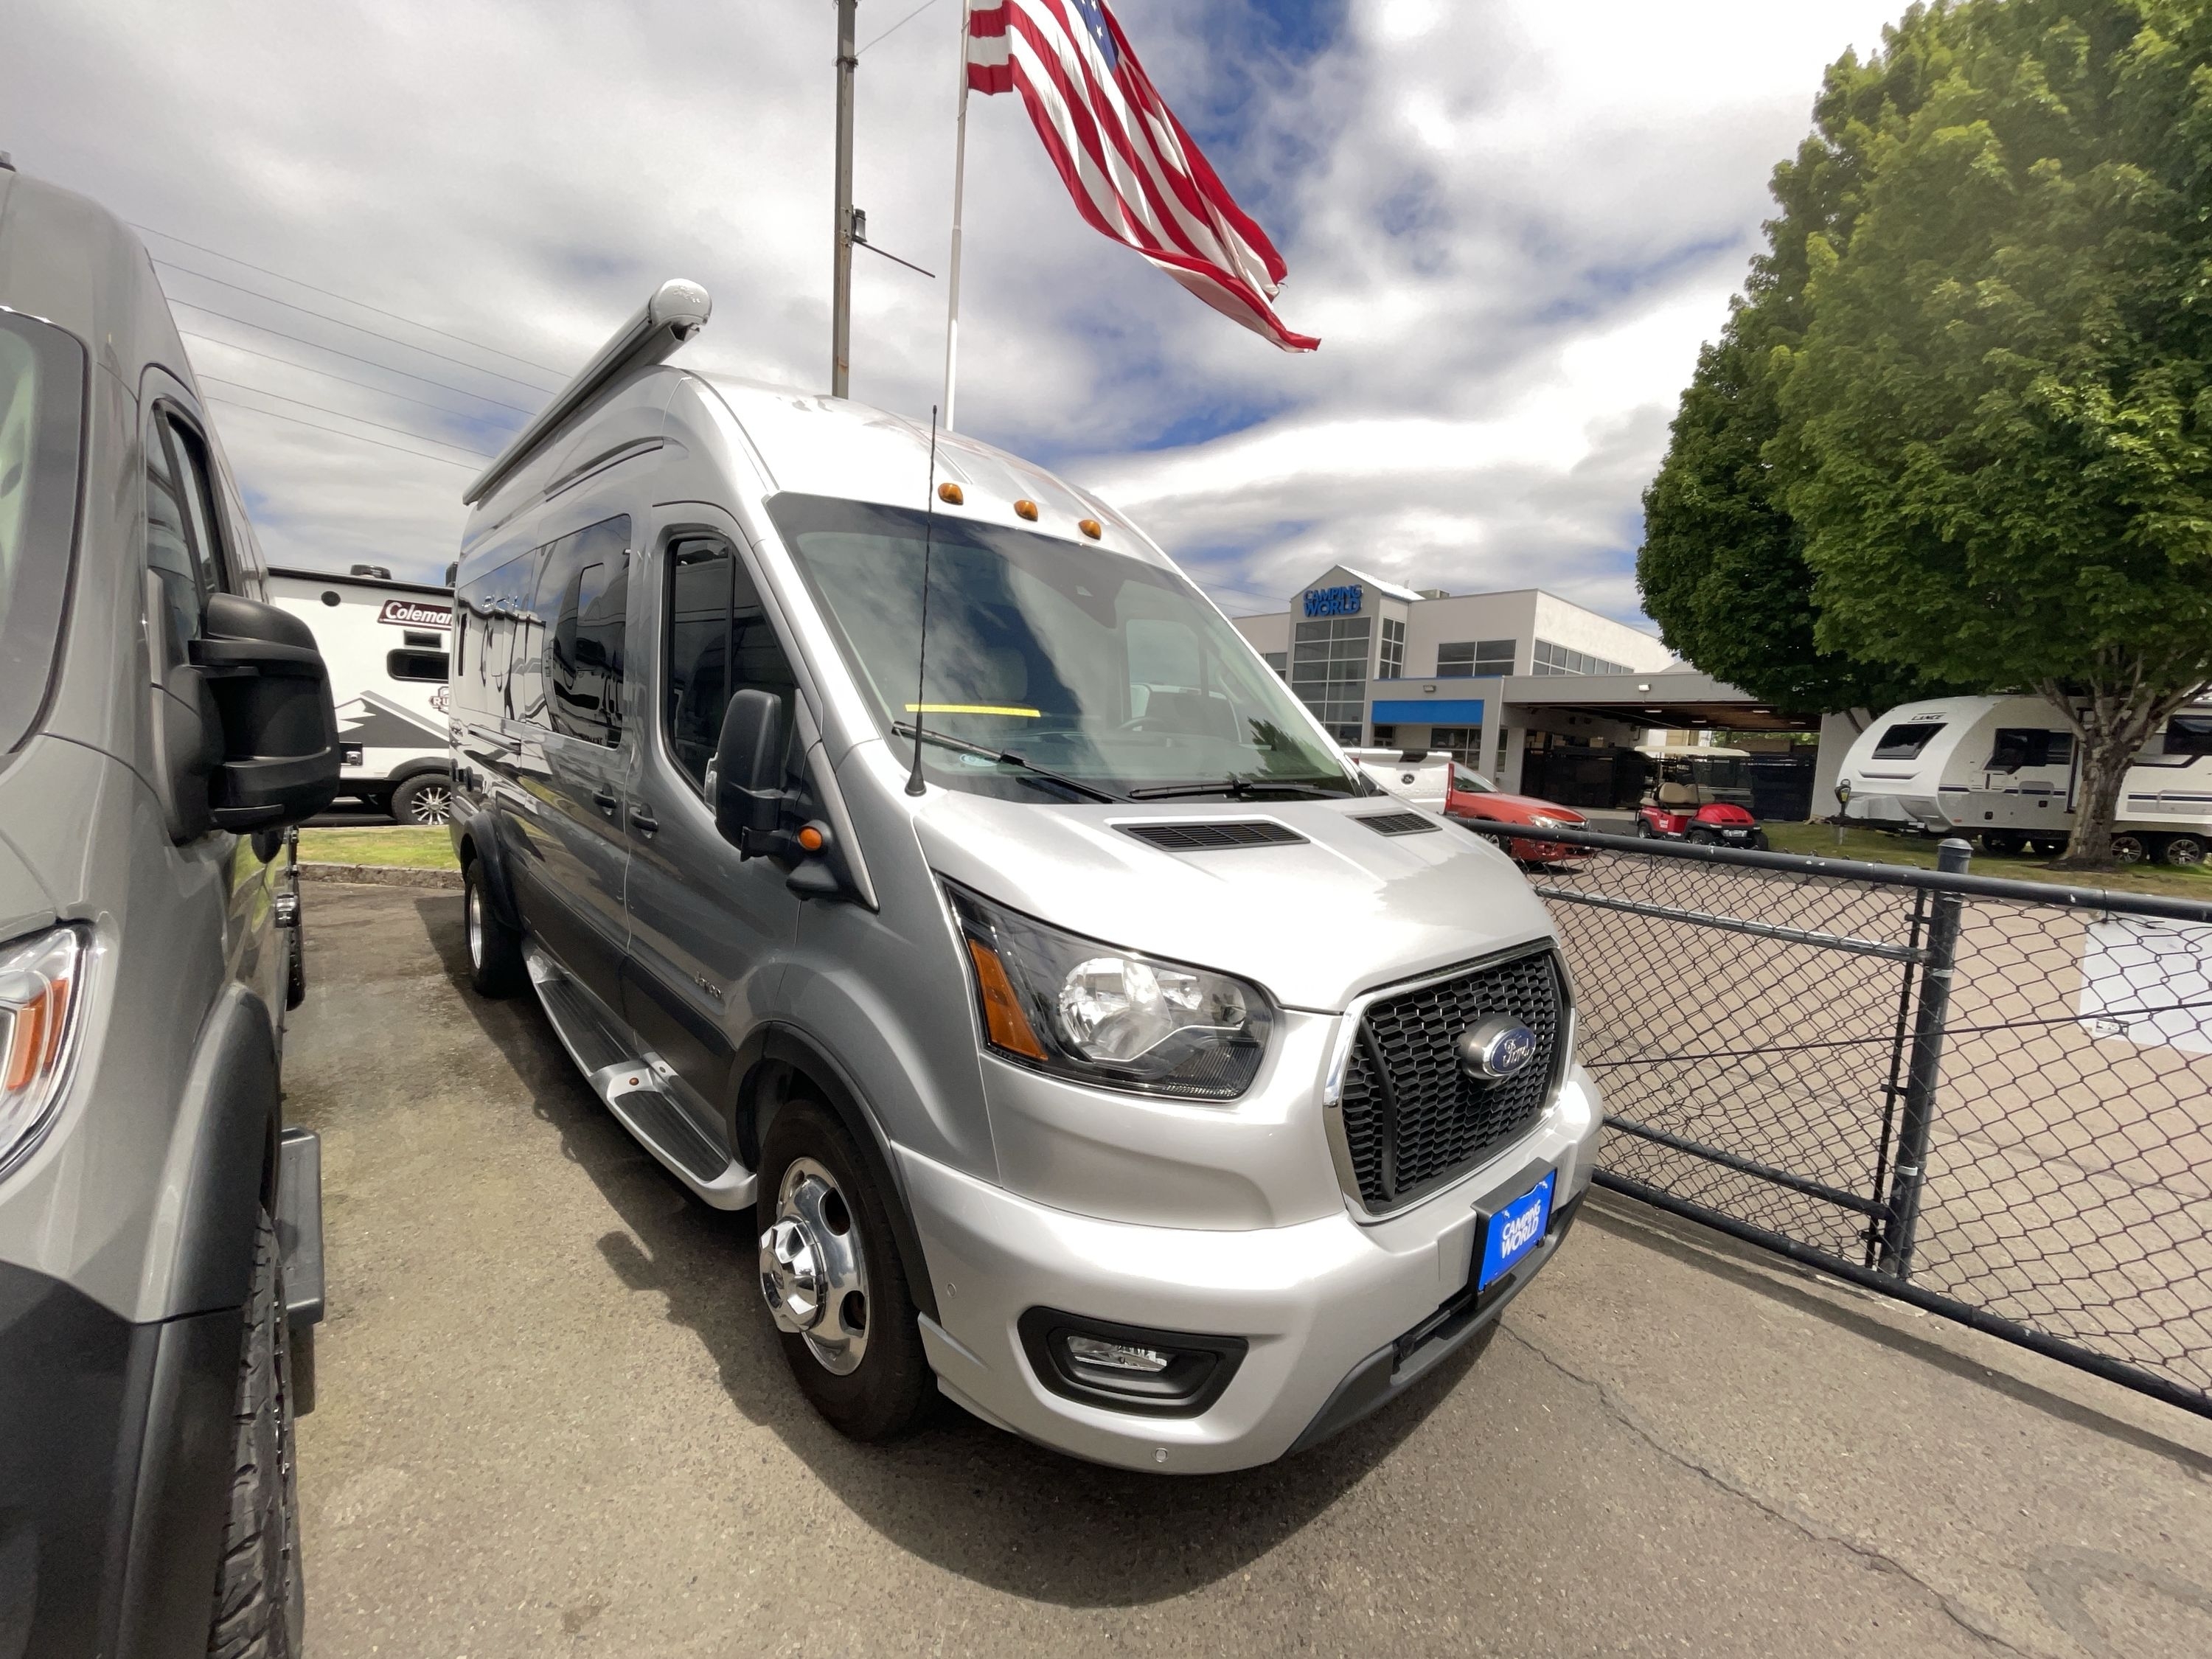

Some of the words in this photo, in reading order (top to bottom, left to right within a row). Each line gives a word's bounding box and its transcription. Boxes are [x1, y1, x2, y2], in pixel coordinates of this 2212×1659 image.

[1303, 584, 1363, 602] CAMPING
[1303, 598, 1361, 617] WORLD
[1503, 1035, 1530, 1067] Ford
[1502, 1199, 1541, 1240] CAMPING
[1501, 1216, 1539, 1259] WORLD
